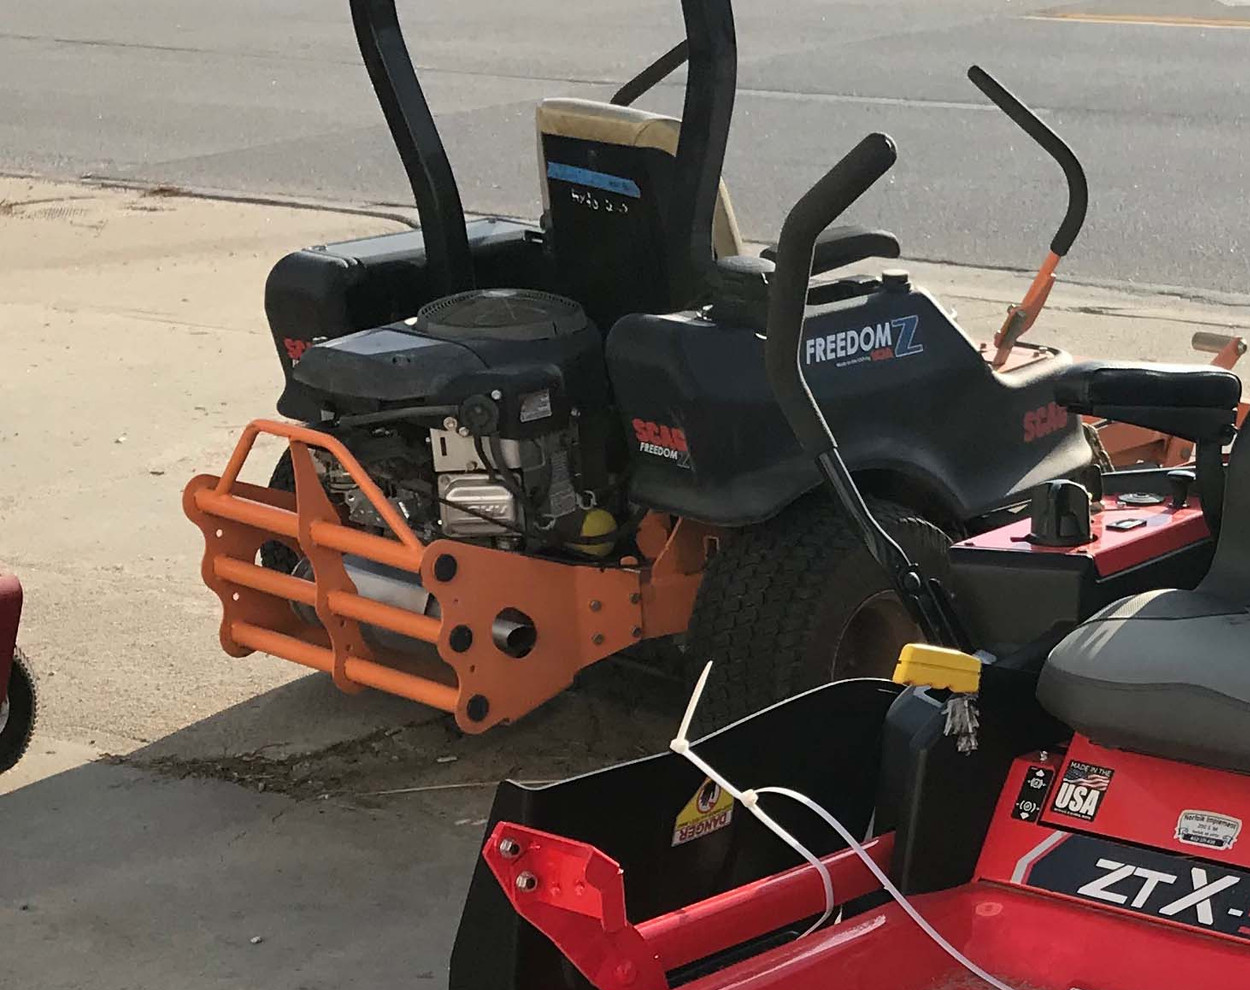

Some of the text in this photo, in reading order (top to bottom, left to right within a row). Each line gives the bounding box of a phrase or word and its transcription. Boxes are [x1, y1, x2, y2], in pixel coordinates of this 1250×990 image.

[806, 315, 924, 365] FREEDOM Z
[632, 418, 688, 452] SCAG
[640, 442, 678, 460] FREEDOM
[1071, 761, 1112, 778] MADE IN THE
[1055, 782, 1100, 816] USA
[679, 811, 728, 841] DANGER
